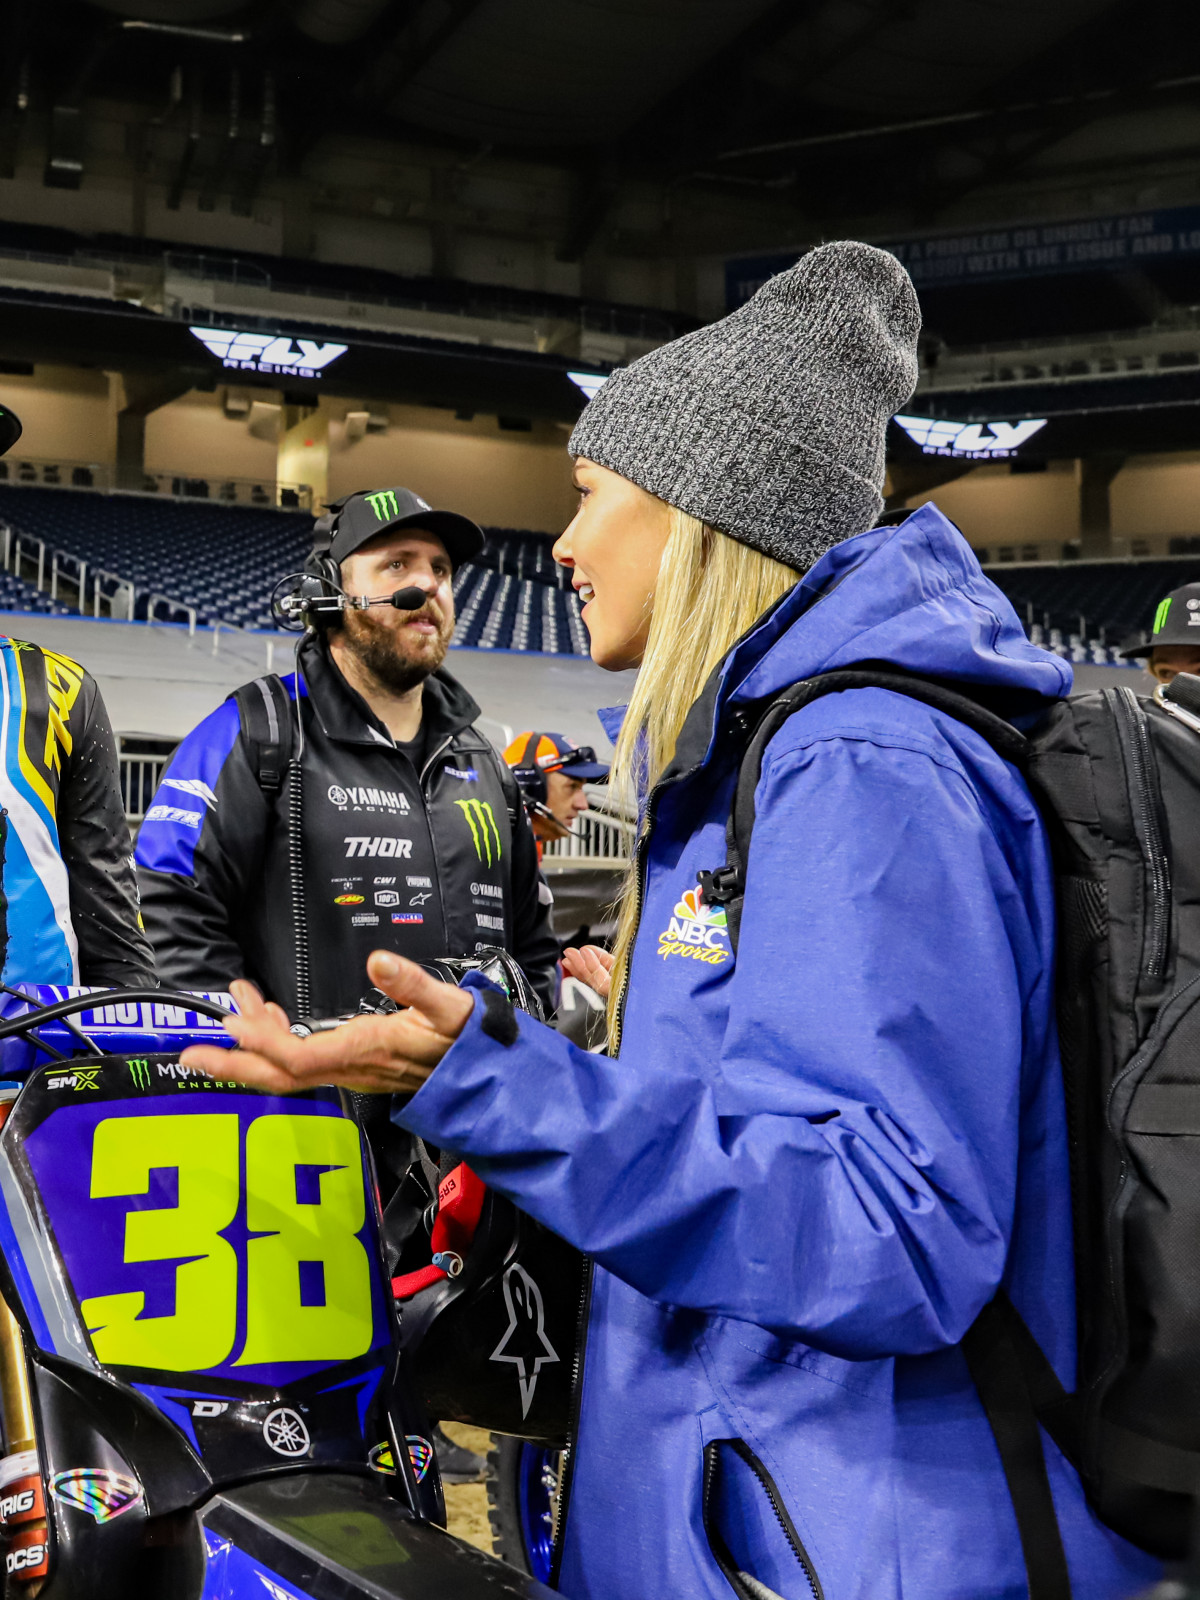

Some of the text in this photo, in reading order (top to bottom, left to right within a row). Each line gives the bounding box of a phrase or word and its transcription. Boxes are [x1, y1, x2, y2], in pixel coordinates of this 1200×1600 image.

[967, 251, 1020, 274] WITH
[1025, 246, 1060, 268] THE
[189, 326, 348, 369] FLY
[223, 358, 315, 378] RACING
[893, 414, 1048, 451] FLY
[338, 805, 409, 816] RACING
[346, 786, 411, 810] YAMAHA
[343, 836, 413, 859] THOR
[668, 916, 728, 949] NBC
[657, 931, 730, 965] Sports
[46, 1069, 101, 1092] SMX
[80, 1113, 373, 1373] 38
